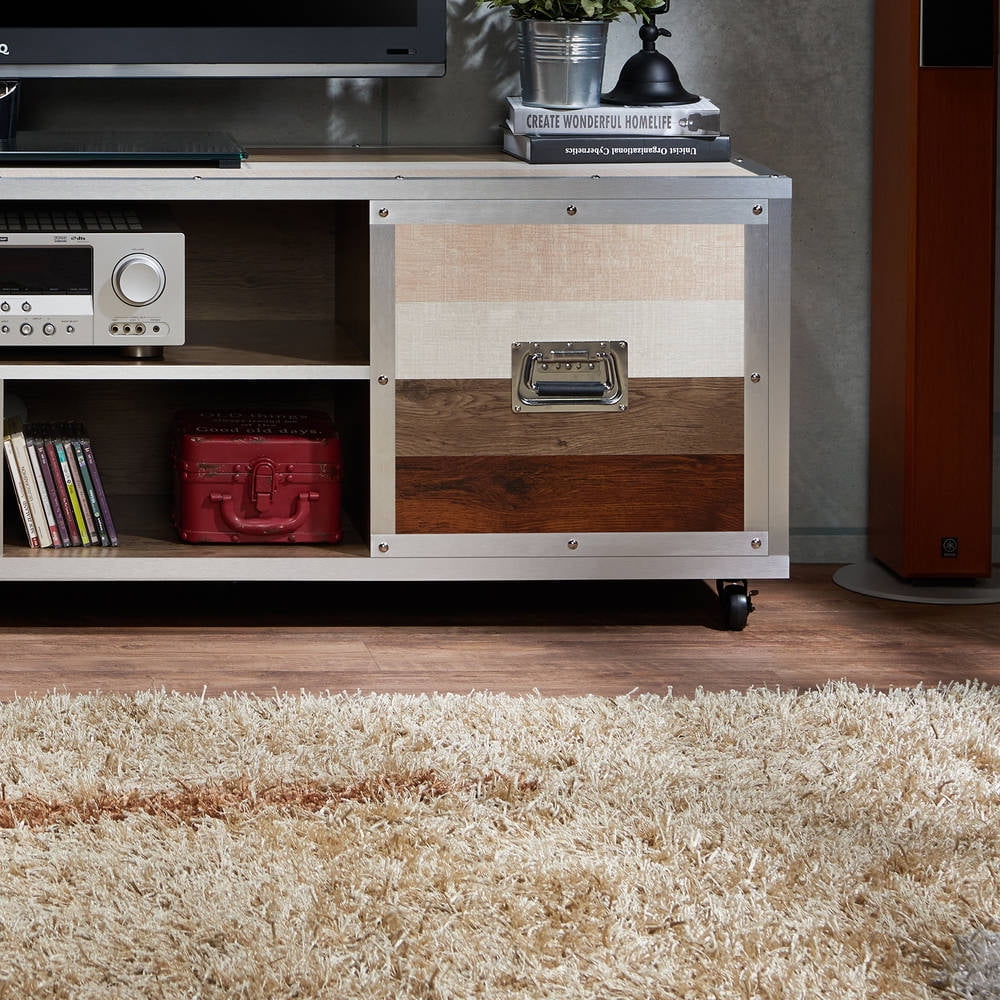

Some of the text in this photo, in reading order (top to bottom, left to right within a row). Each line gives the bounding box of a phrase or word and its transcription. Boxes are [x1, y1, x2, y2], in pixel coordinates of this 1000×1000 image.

[526, 114, 672, 129] CREATE WONDERFUL HOMELIFE
[564, 146, 697, 156] Unicist Organizational Cybernetics
